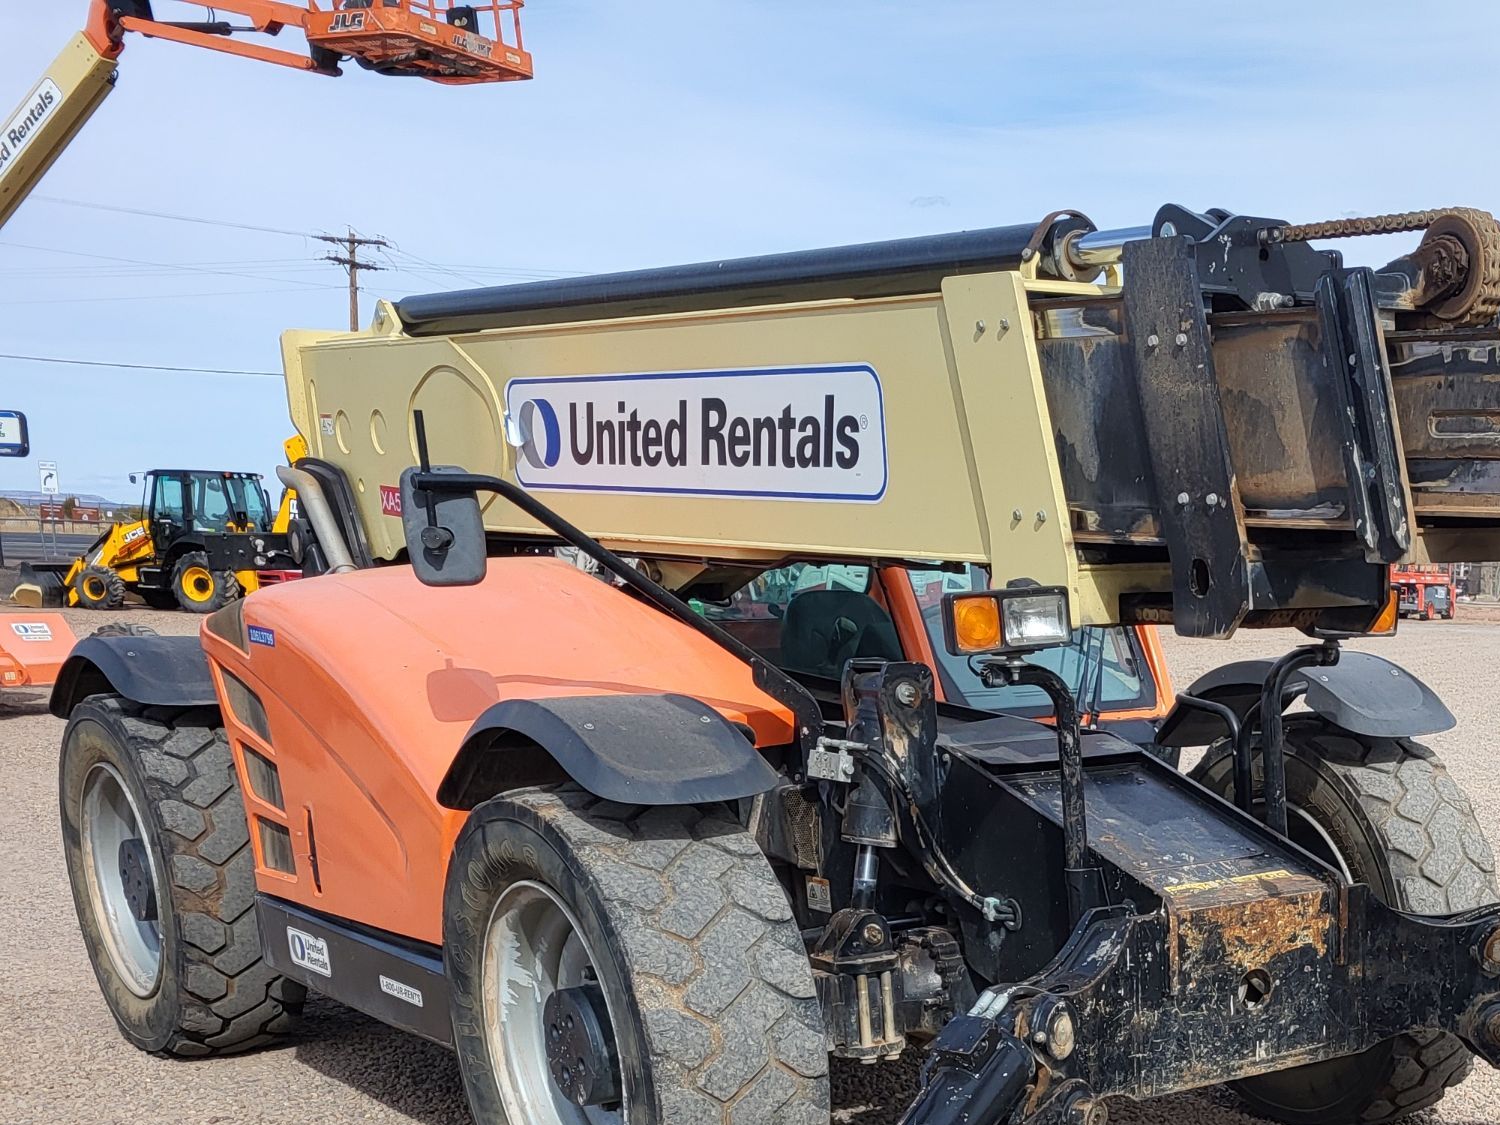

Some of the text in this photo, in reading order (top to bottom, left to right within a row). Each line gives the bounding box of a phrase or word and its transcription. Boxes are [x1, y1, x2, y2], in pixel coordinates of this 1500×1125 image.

[329, 12, 364, 32] JLG
[7, 89, 54, 149] Rentals
[569, 394, 860, 470] United Rentals
[124, 526, 145, 543] JCB
[304, 938, 325, 956] United
[307, 952, 329, 971] Rentals
